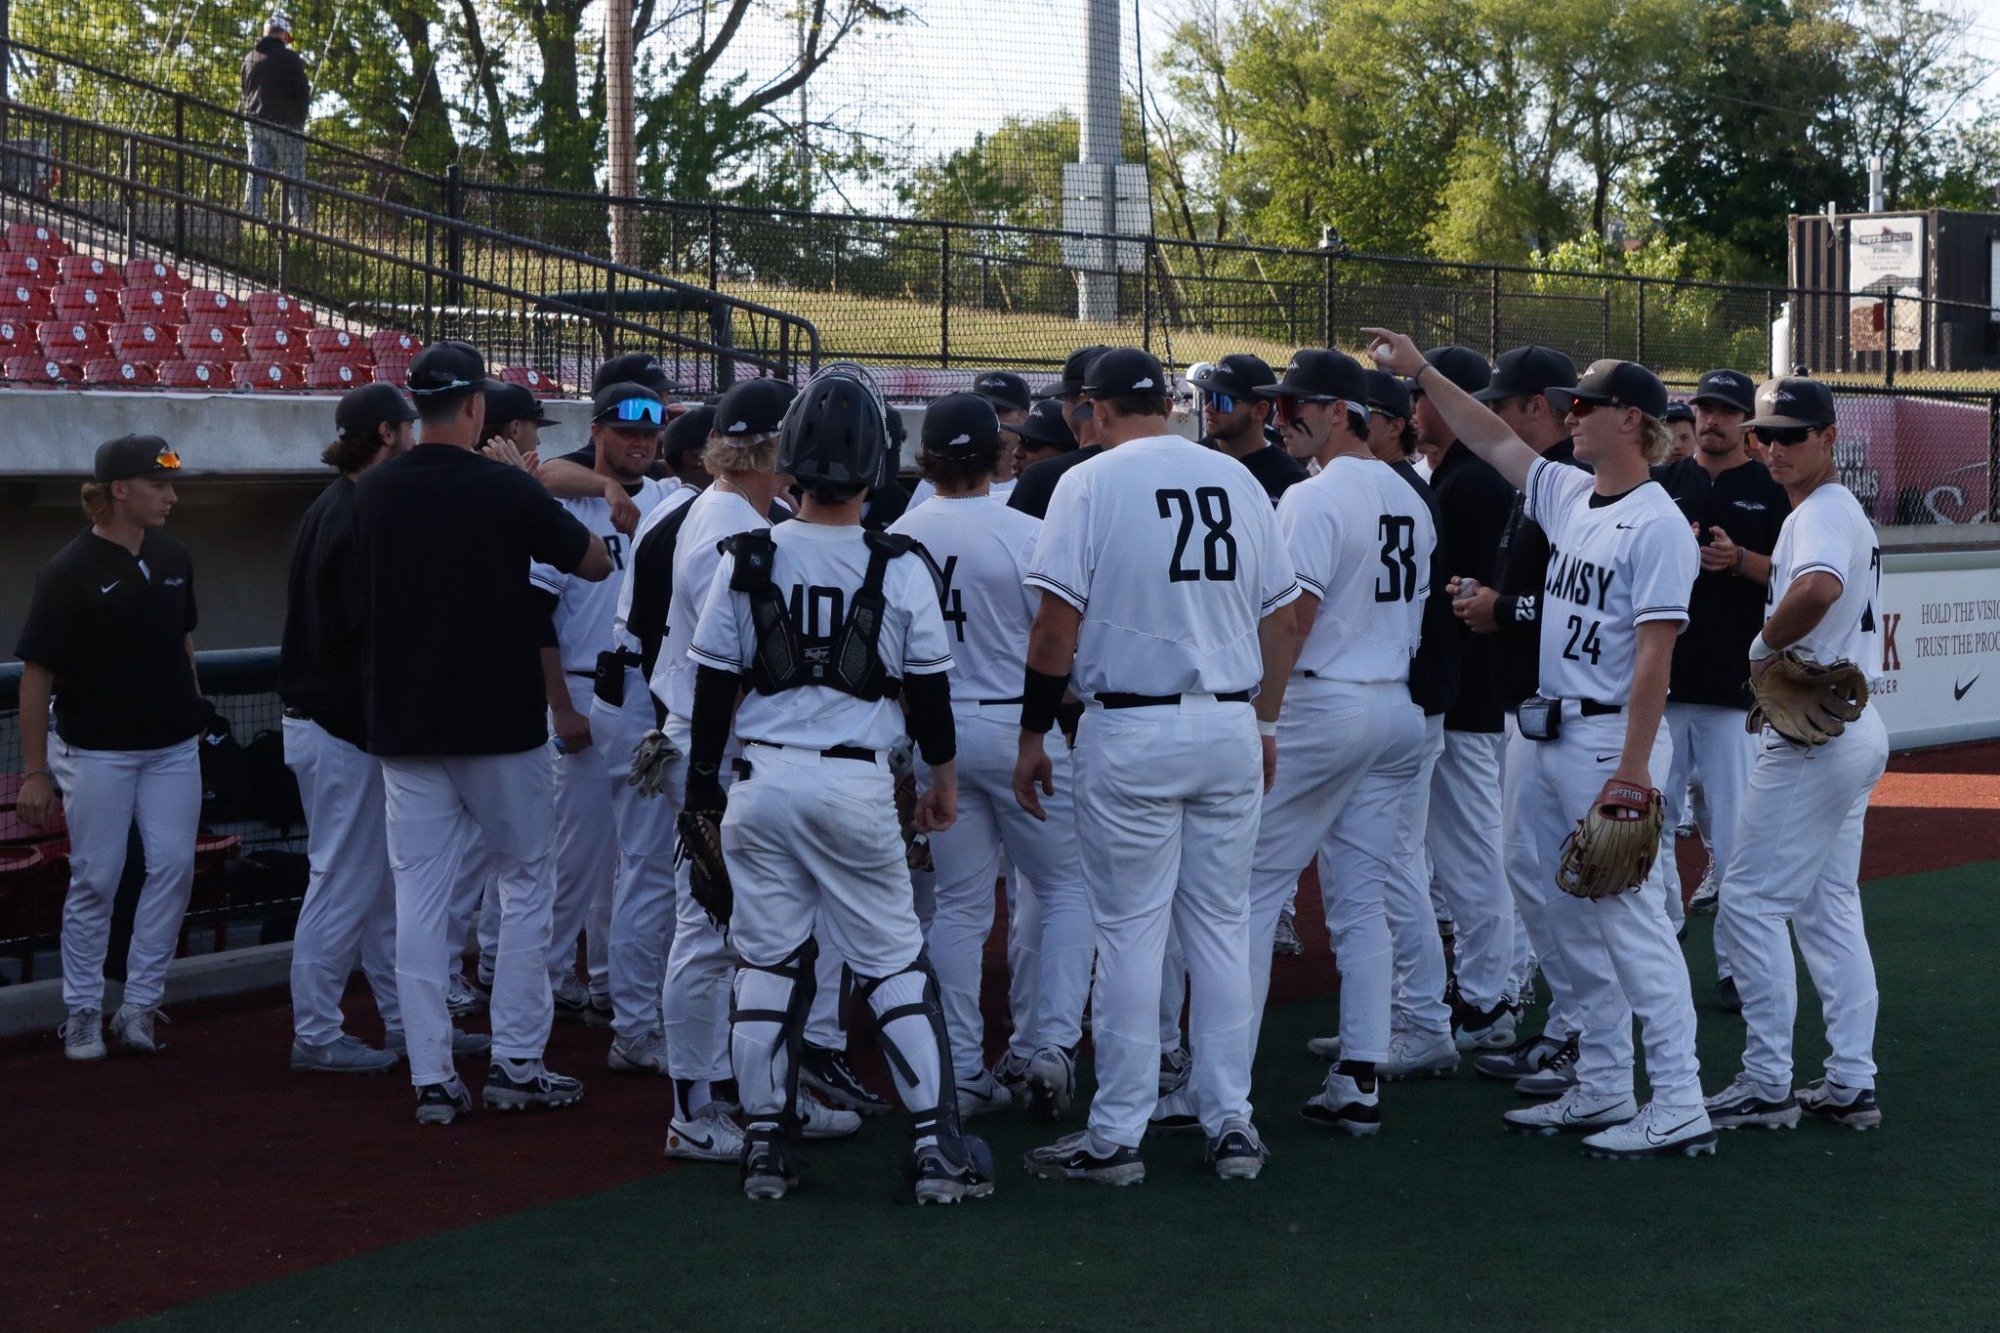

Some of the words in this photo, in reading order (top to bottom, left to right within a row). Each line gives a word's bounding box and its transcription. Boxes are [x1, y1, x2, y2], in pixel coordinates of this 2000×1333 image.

[1155, 486, 1237, 583] 28
[1514, 595, 1536, 621] 22
[1921, 603, 1952, 625] HOLD
[1953, 601, 1974, 623] THE
[1563, 614, 1601, 665] 24
[1915, 635, 1949, 658] TRUST
[1951, 633, 1973, 655] THE
[1608, 788, 1642, 802] Wilson
